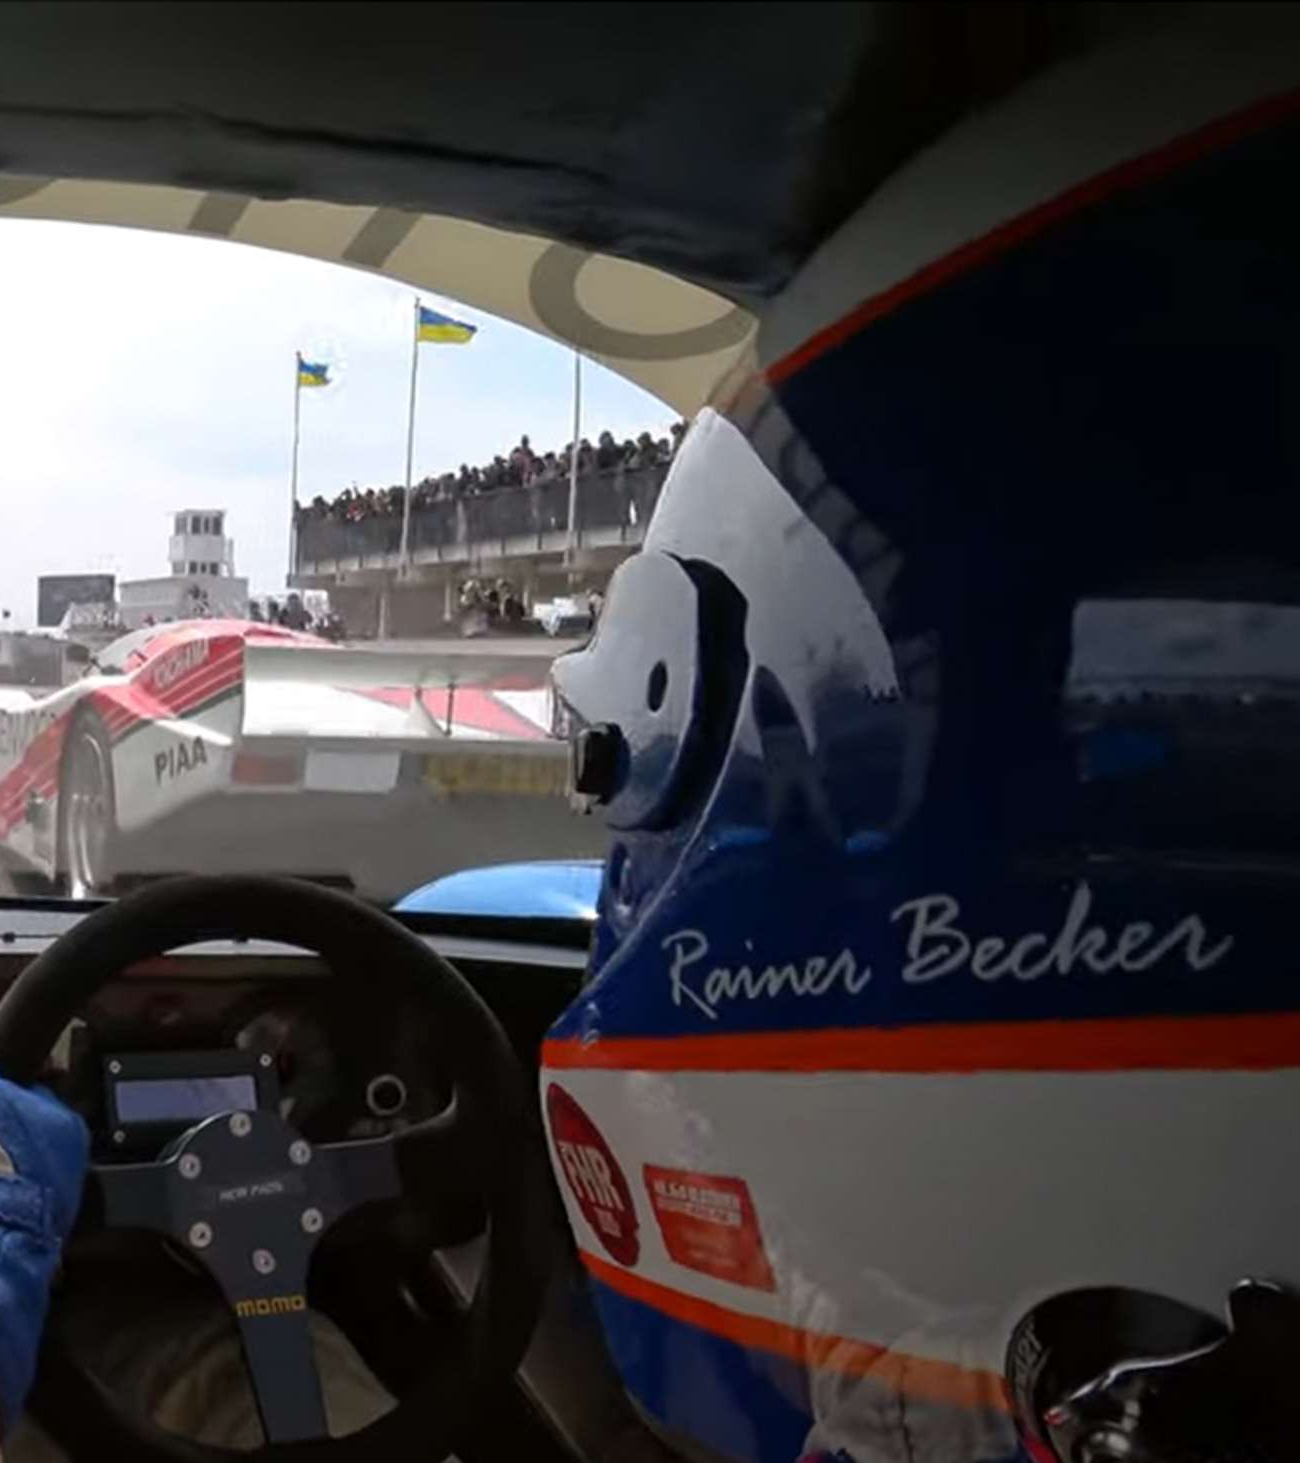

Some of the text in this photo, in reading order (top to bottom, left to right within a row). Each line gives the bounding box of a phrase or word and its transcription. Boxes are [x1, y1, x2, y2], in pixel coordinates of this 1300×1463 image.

[154, 736, 208, 784] PIAA
[662, 880, 1233, 1019] Rainer Becker
